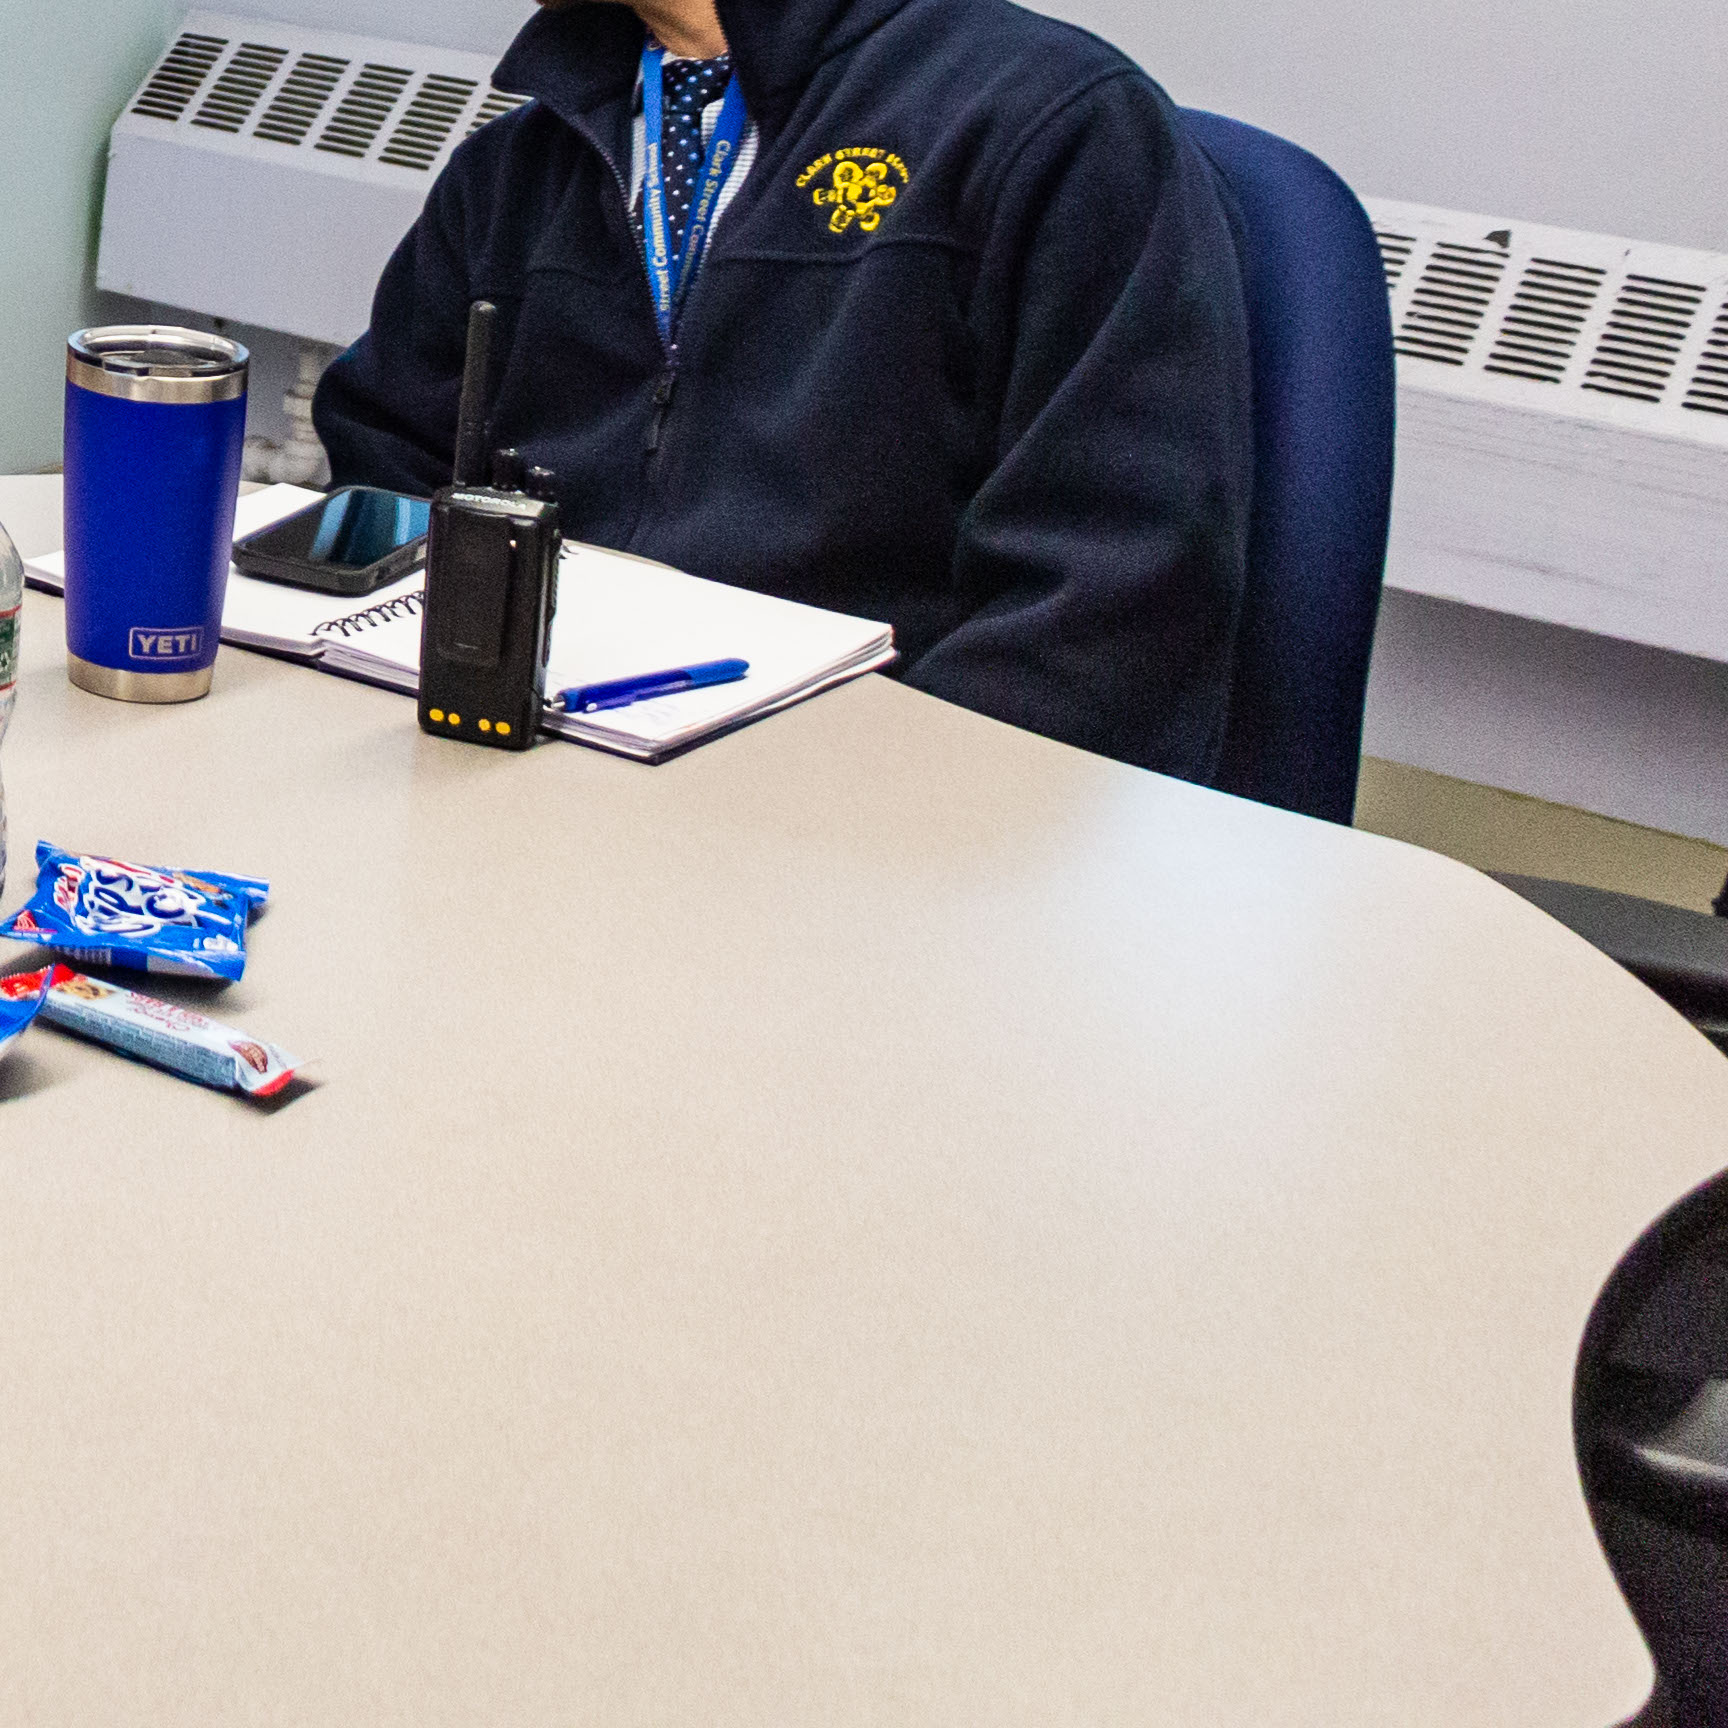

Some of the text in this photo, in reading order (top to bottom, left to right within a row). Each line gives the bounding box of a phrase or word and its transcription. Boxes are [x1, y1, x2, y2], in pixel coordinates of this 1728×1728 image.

[696, 139, 732, 222] Clark Street
[647, 187, 669, 268] Community
[137, 633, 197, 654] YETI
